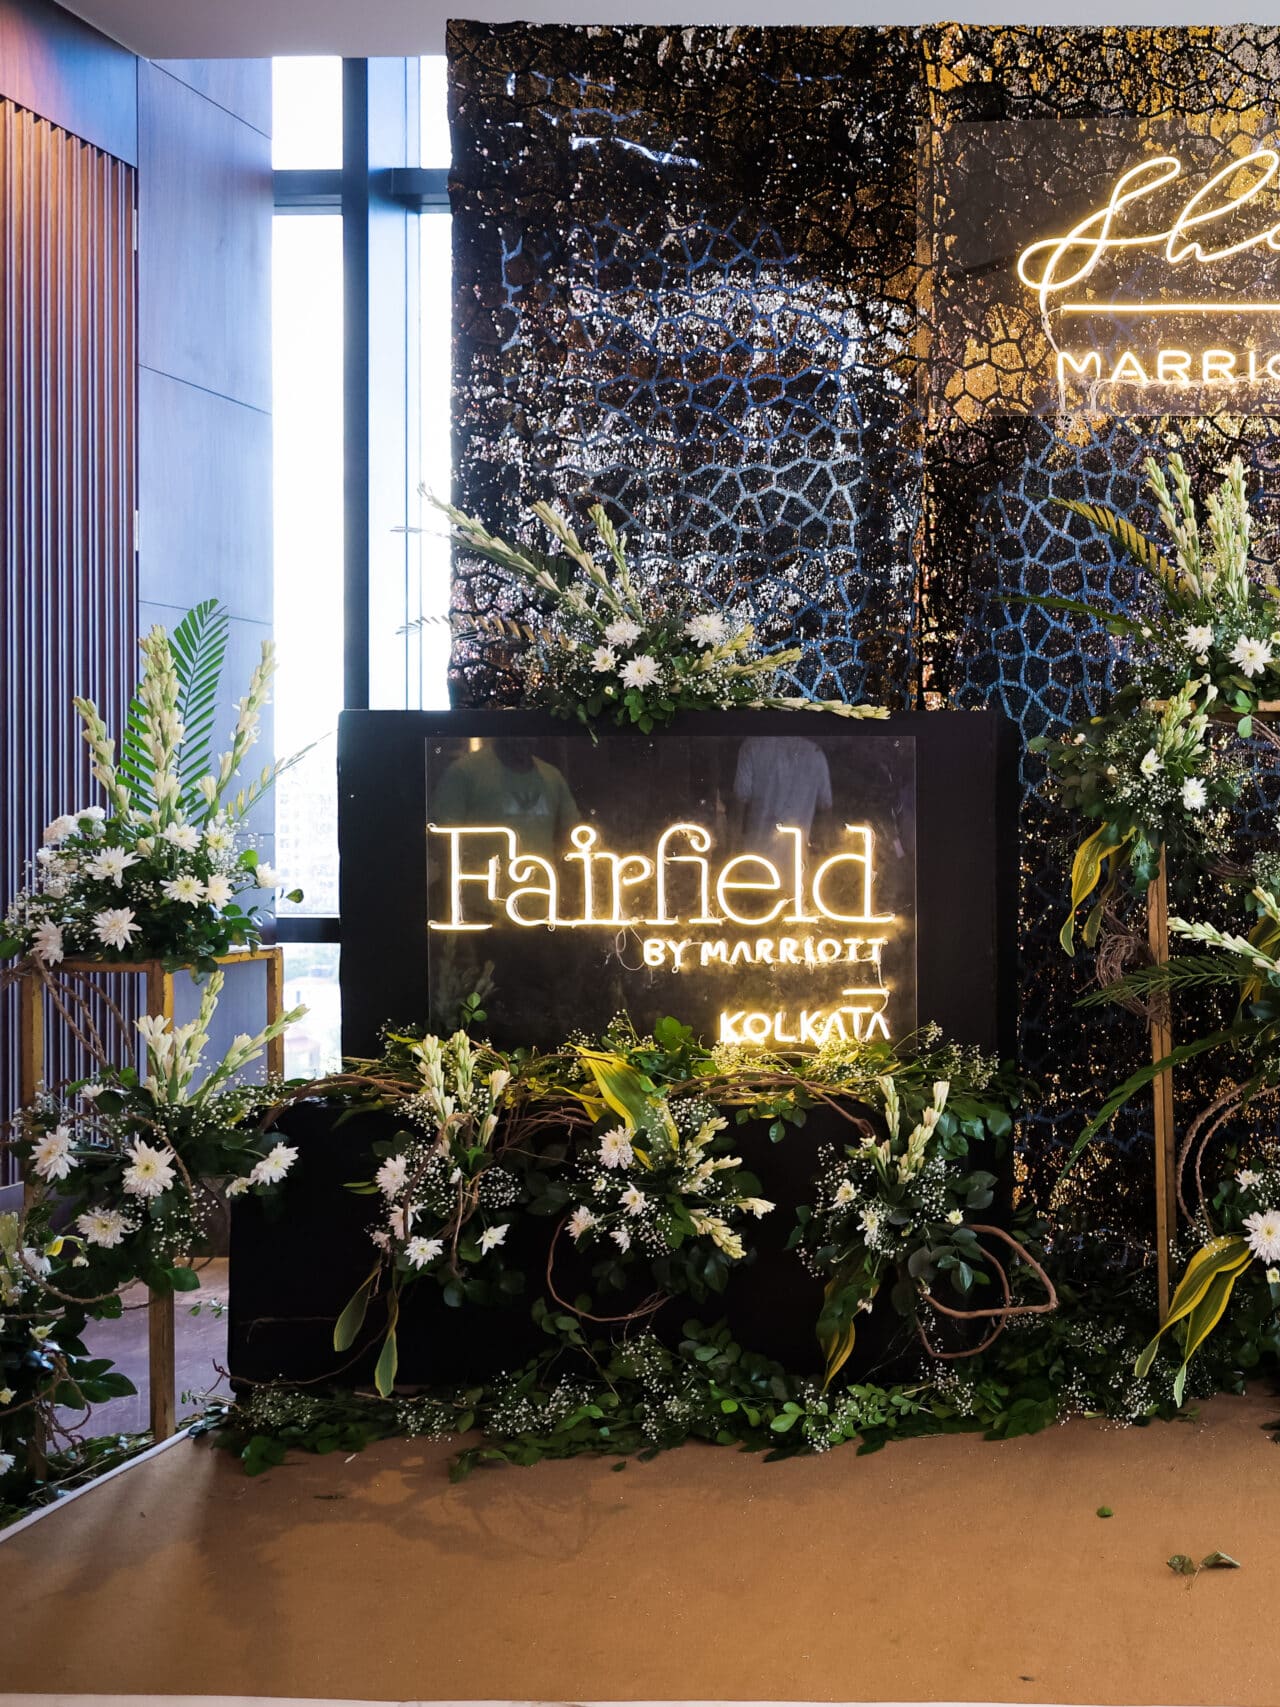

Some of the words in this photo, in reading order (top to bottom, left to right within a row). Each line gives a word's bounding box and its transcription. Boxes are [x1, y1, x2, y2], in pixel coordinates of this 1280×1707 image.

[427, 824, 896, 931] Fairfield
[643, 938, 685, 967] BY
[700, 937, 886, 966] MARRIOTT
[719, 1006, 892, 1046] KOLKATA
